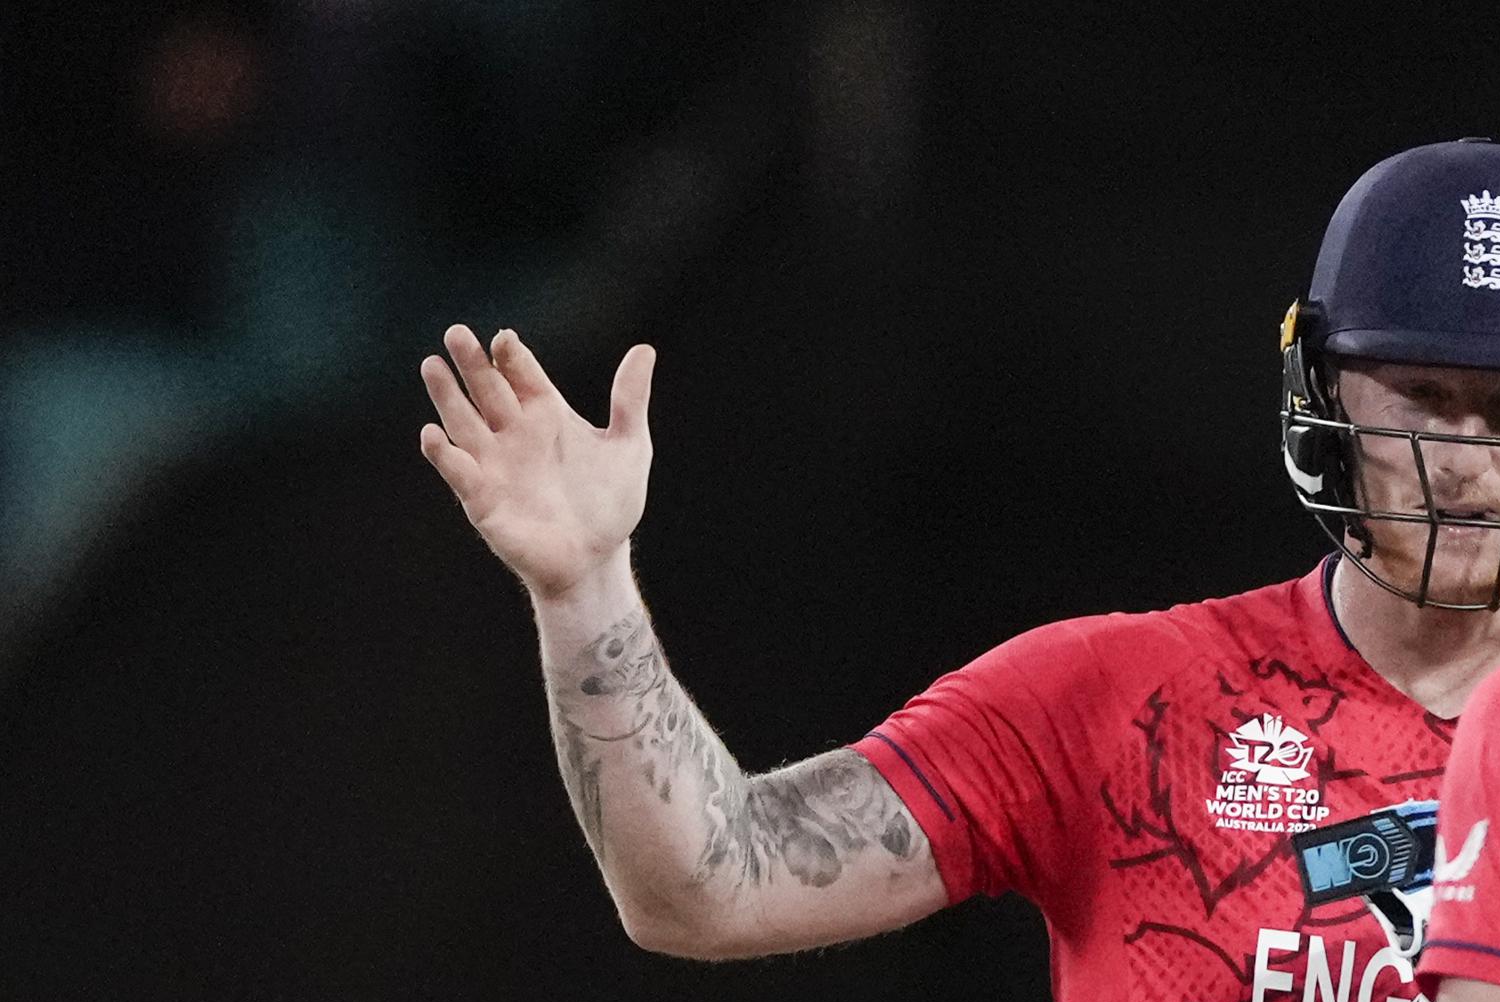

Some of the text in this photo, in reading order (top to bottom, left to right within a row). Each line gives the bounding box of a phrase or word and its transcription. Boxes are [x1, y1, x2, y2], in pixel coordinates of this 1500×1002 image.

[1221, 770, 1247, 783] ICC
[1216, 785, 1320, 804] MEN'S T20
[1206, 799, 1330, 822] WORLD CUP
[1215, 818, 1284, 833] AUSTRALIA
